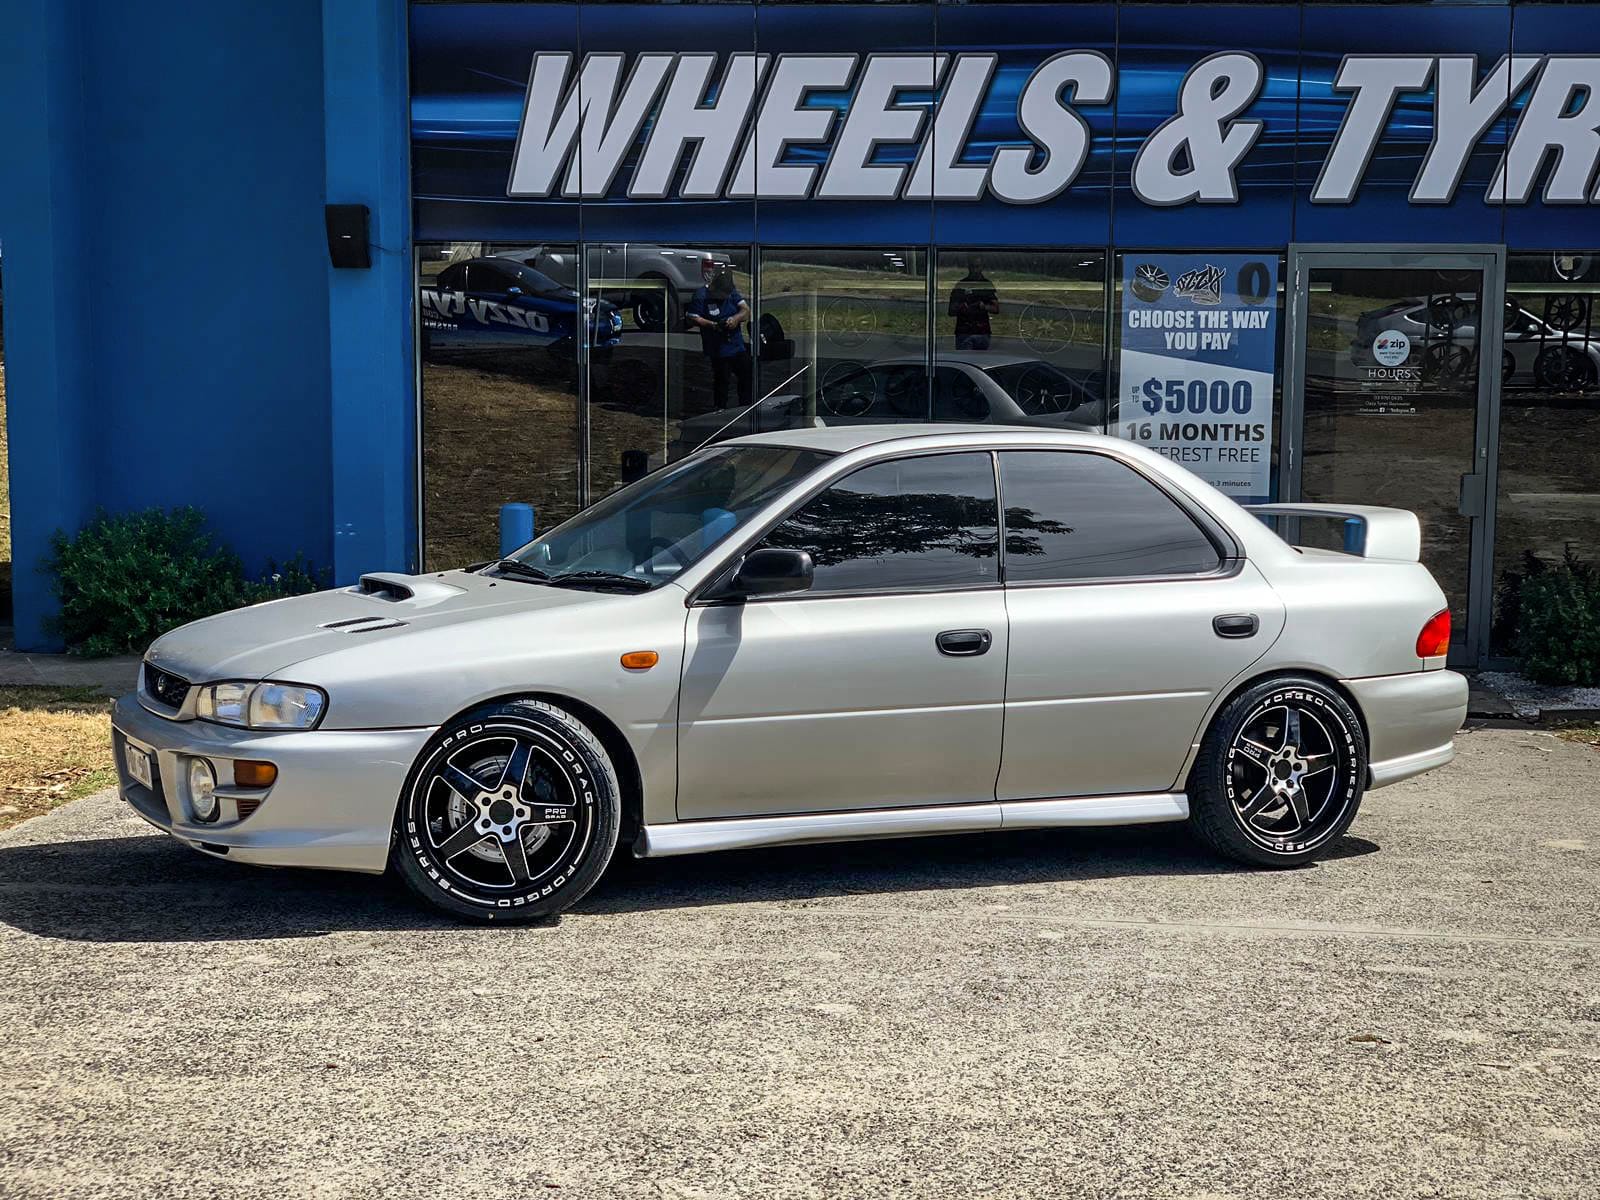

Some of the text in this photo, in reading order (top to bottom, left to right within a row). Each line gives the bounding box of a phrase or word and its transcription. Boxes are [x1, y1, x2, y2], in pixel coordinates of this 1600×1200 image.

[506, 49, 1600, 205] WHEELS & TYR
[1128, 310, 1270, 329] CHOOSE THE WAY
[1165, 332, 1232, 351] YOU PAY
[1389, 339, 1406, 350] zip
[1368, 368, 1411, 378] HOURS
[1131, 386, 1140, 394] UP
[1131, 395, 1140, 404] TO
[1142, 377, 1253, 416] $5000
[1126, 422, 1265, 442] 16 MONTHS
[1218, 447, 1260, 463] FREE
[1263, 692, 1324, 707] FORGED
[442, 724, 483, 748] PRO
[1243, 746, 1261, 759] PRO
[1226, 748, 1236, 798] DRAG
[1344, 732, 1357, 798] SERIES
[562, 749, 594, 804] DRAG
[407, 821, 451, 890] SERIES
[1274, 842, 1305, 851] PRO
[497, 863, 576, 907] FORGED
